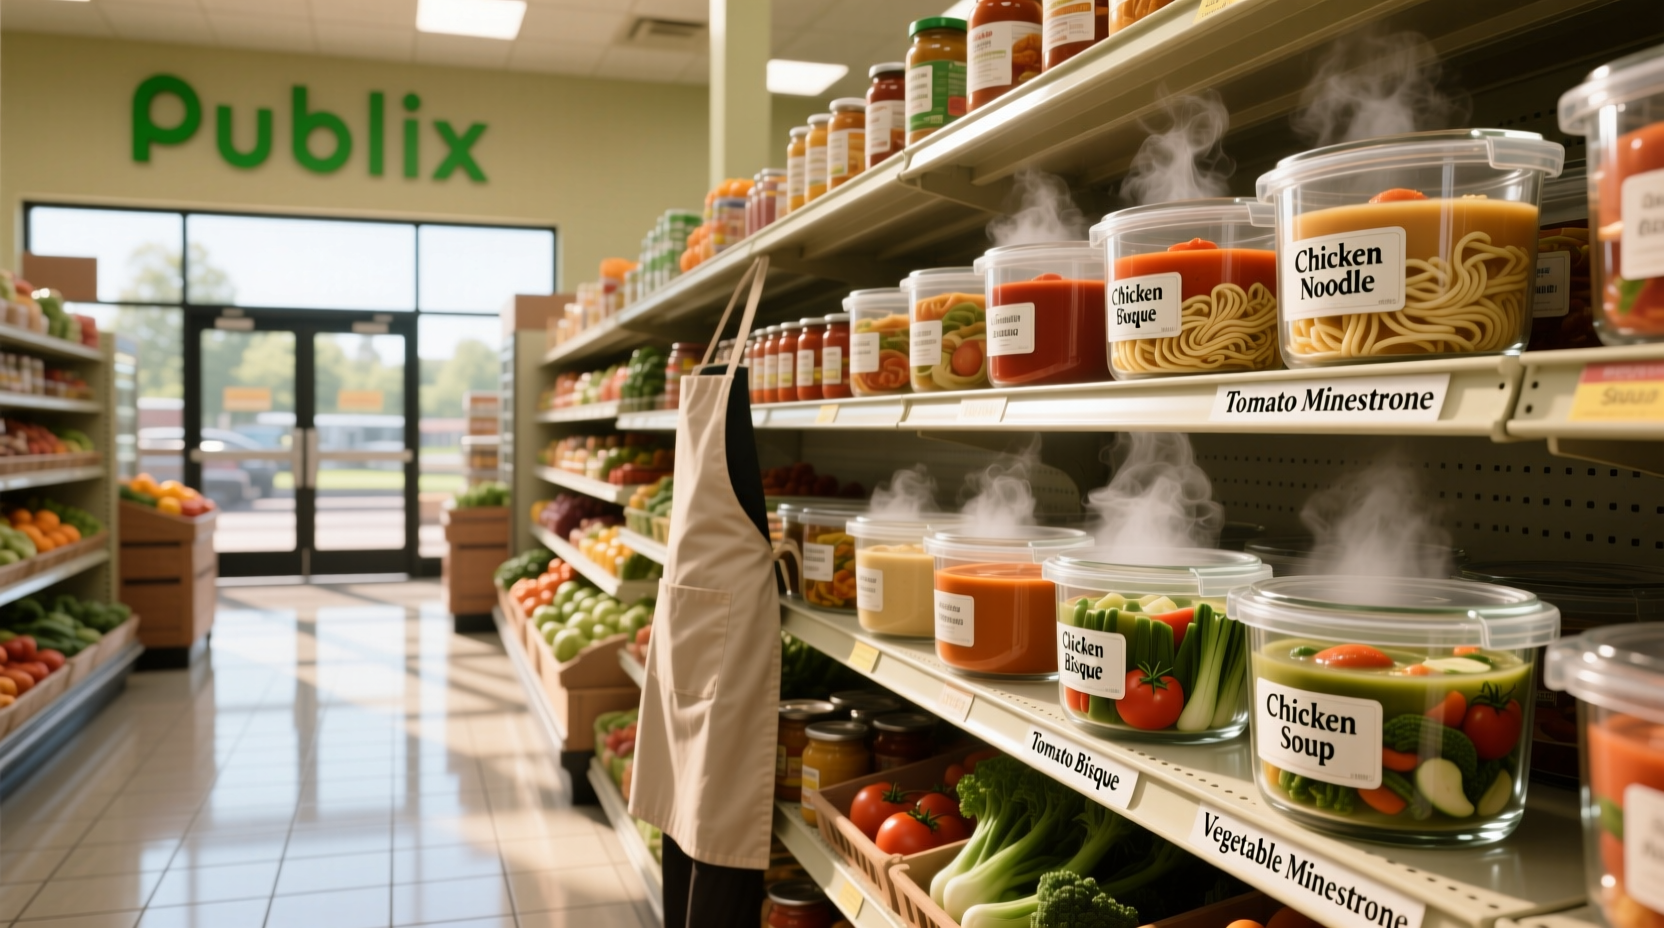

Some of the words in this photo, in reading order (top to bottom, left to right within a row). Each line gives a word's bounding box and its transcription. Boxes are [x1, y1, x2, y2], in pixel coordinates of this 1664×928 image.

[132, 73, 489, 183] Publix
[1294, 242, 1383, 274] Chicken
[1111, 284, 1163, 306] Chicken
[1300, 269, 1375, 300] Noodle
[1226, 390, 1298, 413] Tomato
[1300, 386, 1434, 412] Minestrone
[1064, 652, 1103, 680] Bisque
[1266, 693, 1357, 735] Chicken
[1280, 725, 1335, 767] Soup
[1074, 751, 1120, 791] Bisque
[1204, 812, 1283, 874] Vegetable
[1284, 853, 1408, 928] Minestrone
